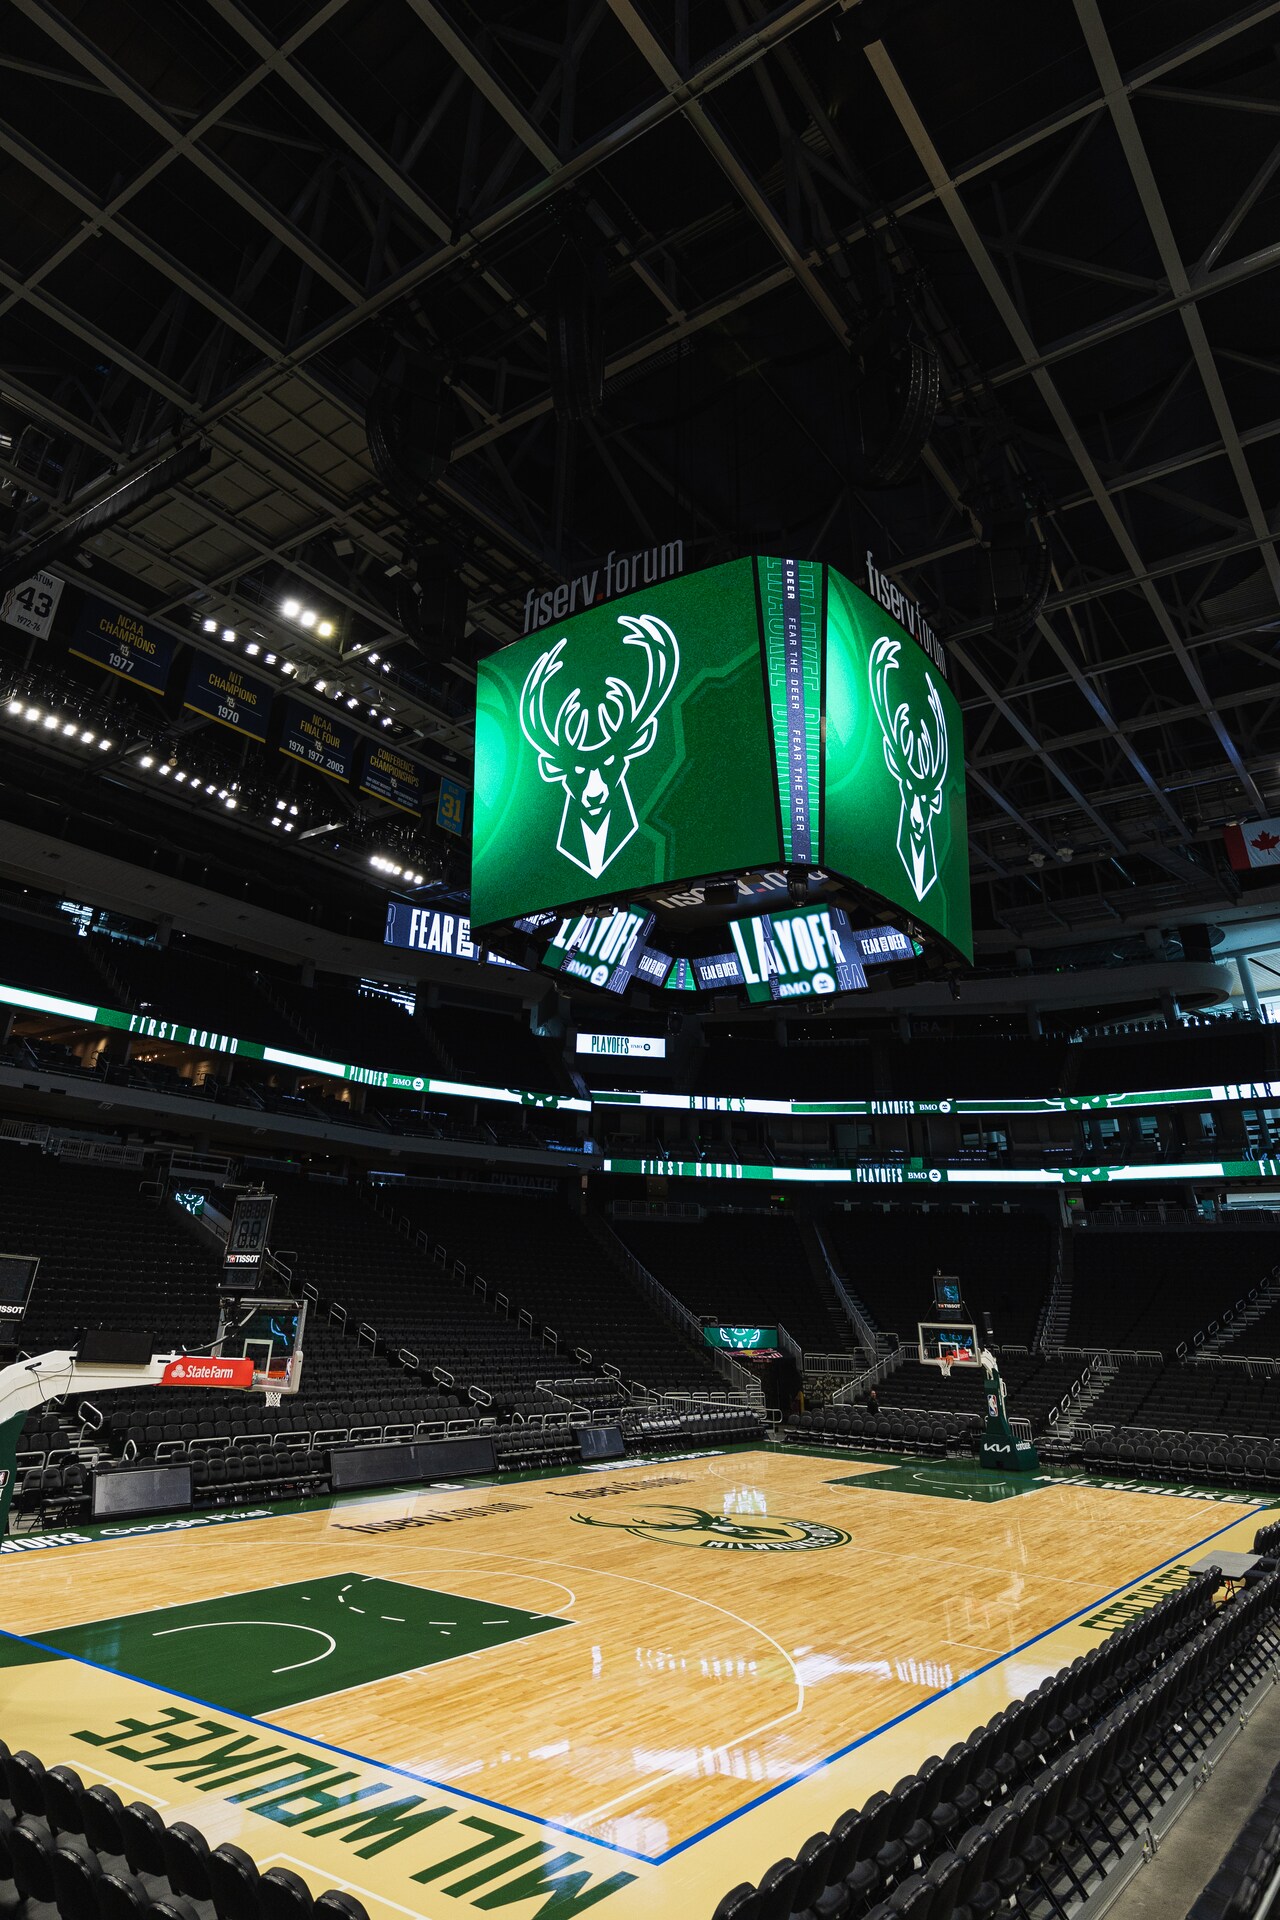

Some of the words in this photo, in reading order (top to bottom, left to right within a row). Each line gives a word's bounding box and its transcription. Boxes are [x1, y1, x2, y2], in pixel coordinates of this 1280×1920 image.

[31, 574, 53, 589] ATUM
[786, 570, 796, 600] DEER
[16, 587, 52, 618] 43
[16, 614, 41, 632] 1972-76
[118, 614, 144, 637] NCAA
[788, 617, 797, 646] FEAR
[99, 618, 156, 655] CHAMPIONS
[109, 653, 134, 673] 1977
[789, 652, 798, 674] THE
[208, 673, 257, 706] CHAMPIONS
[228, 671, 244, 686] NIT
[791, 679, 800, 710] DEER
[217, 705, 239, 724] 1970
[312, 714, 332, 733] NCAA
[300, 720, 321, 741] FINAL
[321, 732, 341, 749] FOUR
[793, 729, 802, 761] FEAR
[288, 739, 305, 755] 1974
[307, 749, 324, 764] 1977
[326, 758, 344, 774] 2003
[377, 748, 415, 775] CONFERENCE
[370, 755, 419, 787] CHAMPIONSHIPS
[794, 768, 803, 791] THE
[441, 793, 461, 823] 31
[795, 798, 805, 831] DEER
[408, 908, 455, 954] FEAR
[861, 937, 881, 955] FEAR
[887, 933, 907, 951] DEER
[700, 965, 717, 981] FEAR
[722, 961, 739, 977] DEER
[129, 1014, 178, 1041] FIRST
[188, 1029, 238, 1054] ROUND
[891, 1021, 941, 1033] UTRA
[591, 1035, 630, 1054] PLAYOFFS
[349, 1065, 388, 1087] PLAYOFFS
[392, 1077, 411, 1086] BMO
[1224, 1083, 1272, 1100] FEAR
[690, 1096, 745, 1111] BUCKS
[871, 1101, 915, 1114] PLAYOFFS
[641, 1160, 684, 1175] FIRST
[695, 1162, 742, 1178] ROUND
[856, 1168, 903, 1183] PLAYOFFS
[1032, 1475, 1278, 1506] MILWAUKEE
[100, 1519, 210, 1536] Google
[206, 1509, 274, 1522] Pixel
[70, 1706, 639, 1920] MILWAUKEE
